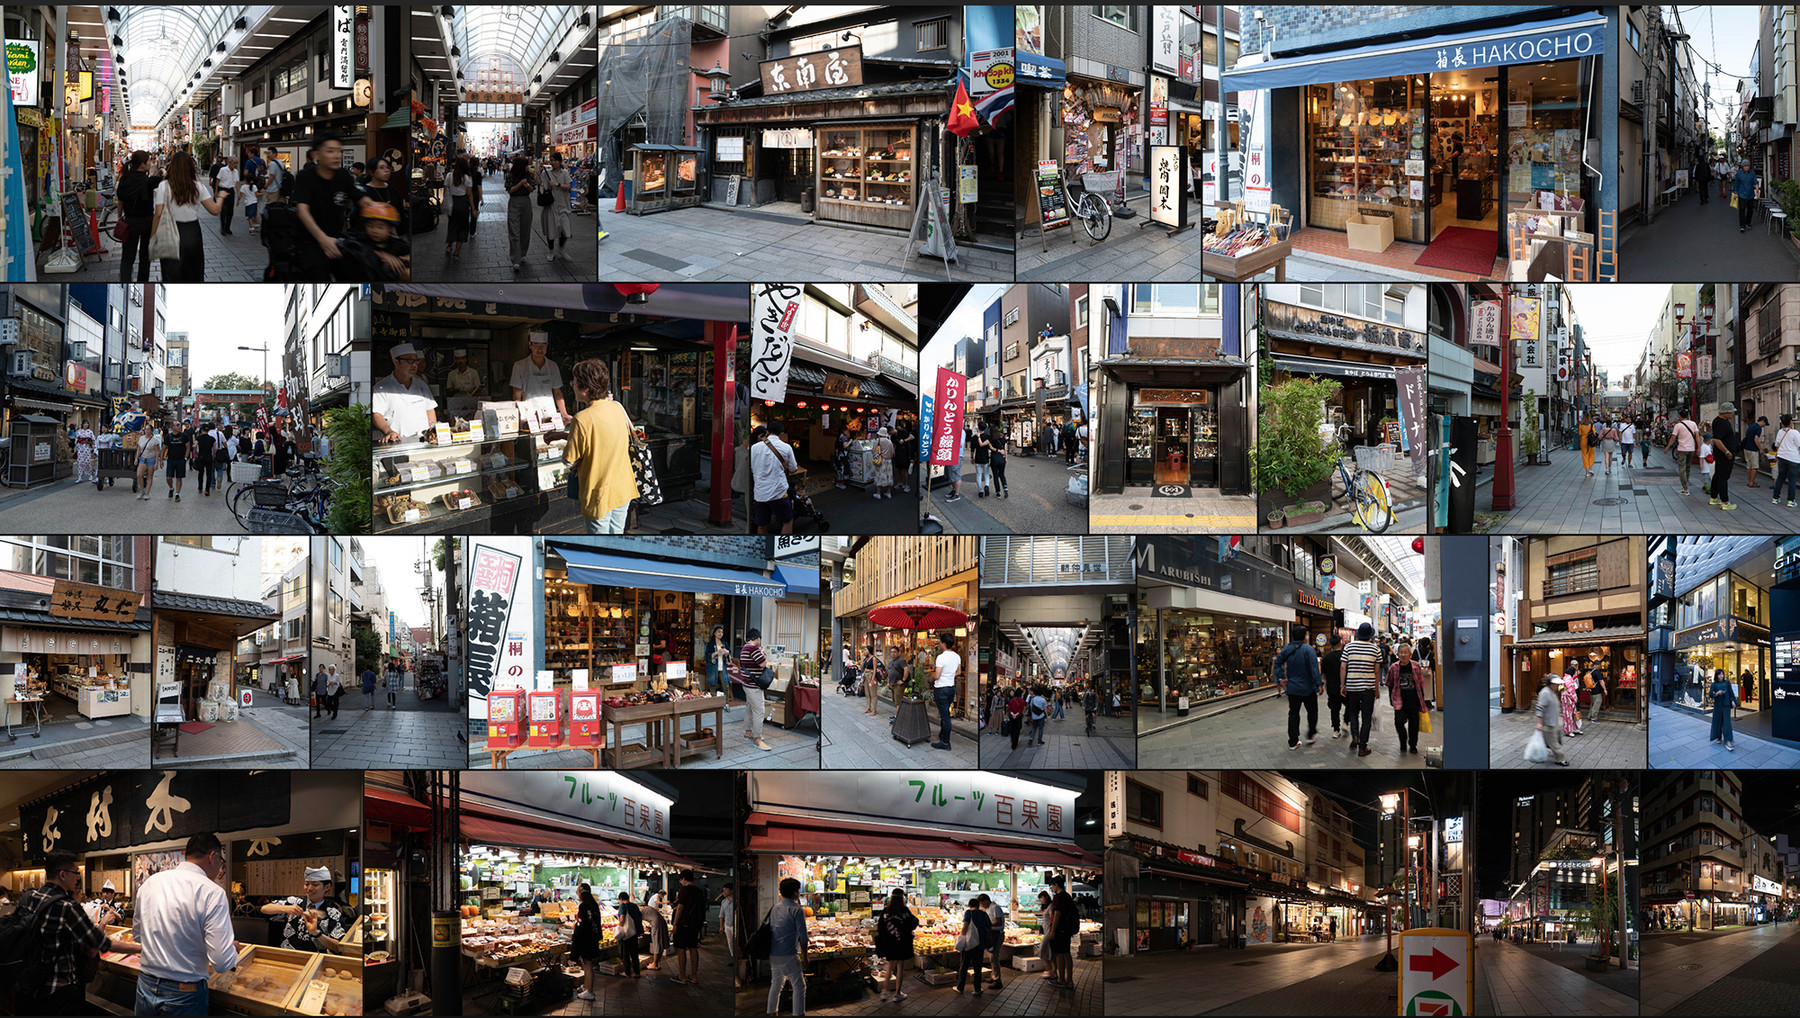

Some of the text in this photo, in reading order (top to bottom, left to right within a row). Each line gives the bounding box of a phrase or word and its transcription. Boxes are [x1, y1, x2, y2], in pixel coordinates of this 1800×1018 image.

[1473, 33, 1593, 65] HAKOCHO
[1021, 62, 1053, 79] 喫茶
[1405, 383, 1423, 456] ドーナツ
[748, 585, 784, 598] HAKOCHO
[1318, 599, 1334, 612] COFFEE
[564, 775, 663, 836] フルーツ 百果園
[908, 780, 1063, 832] フルーツ 百果園
